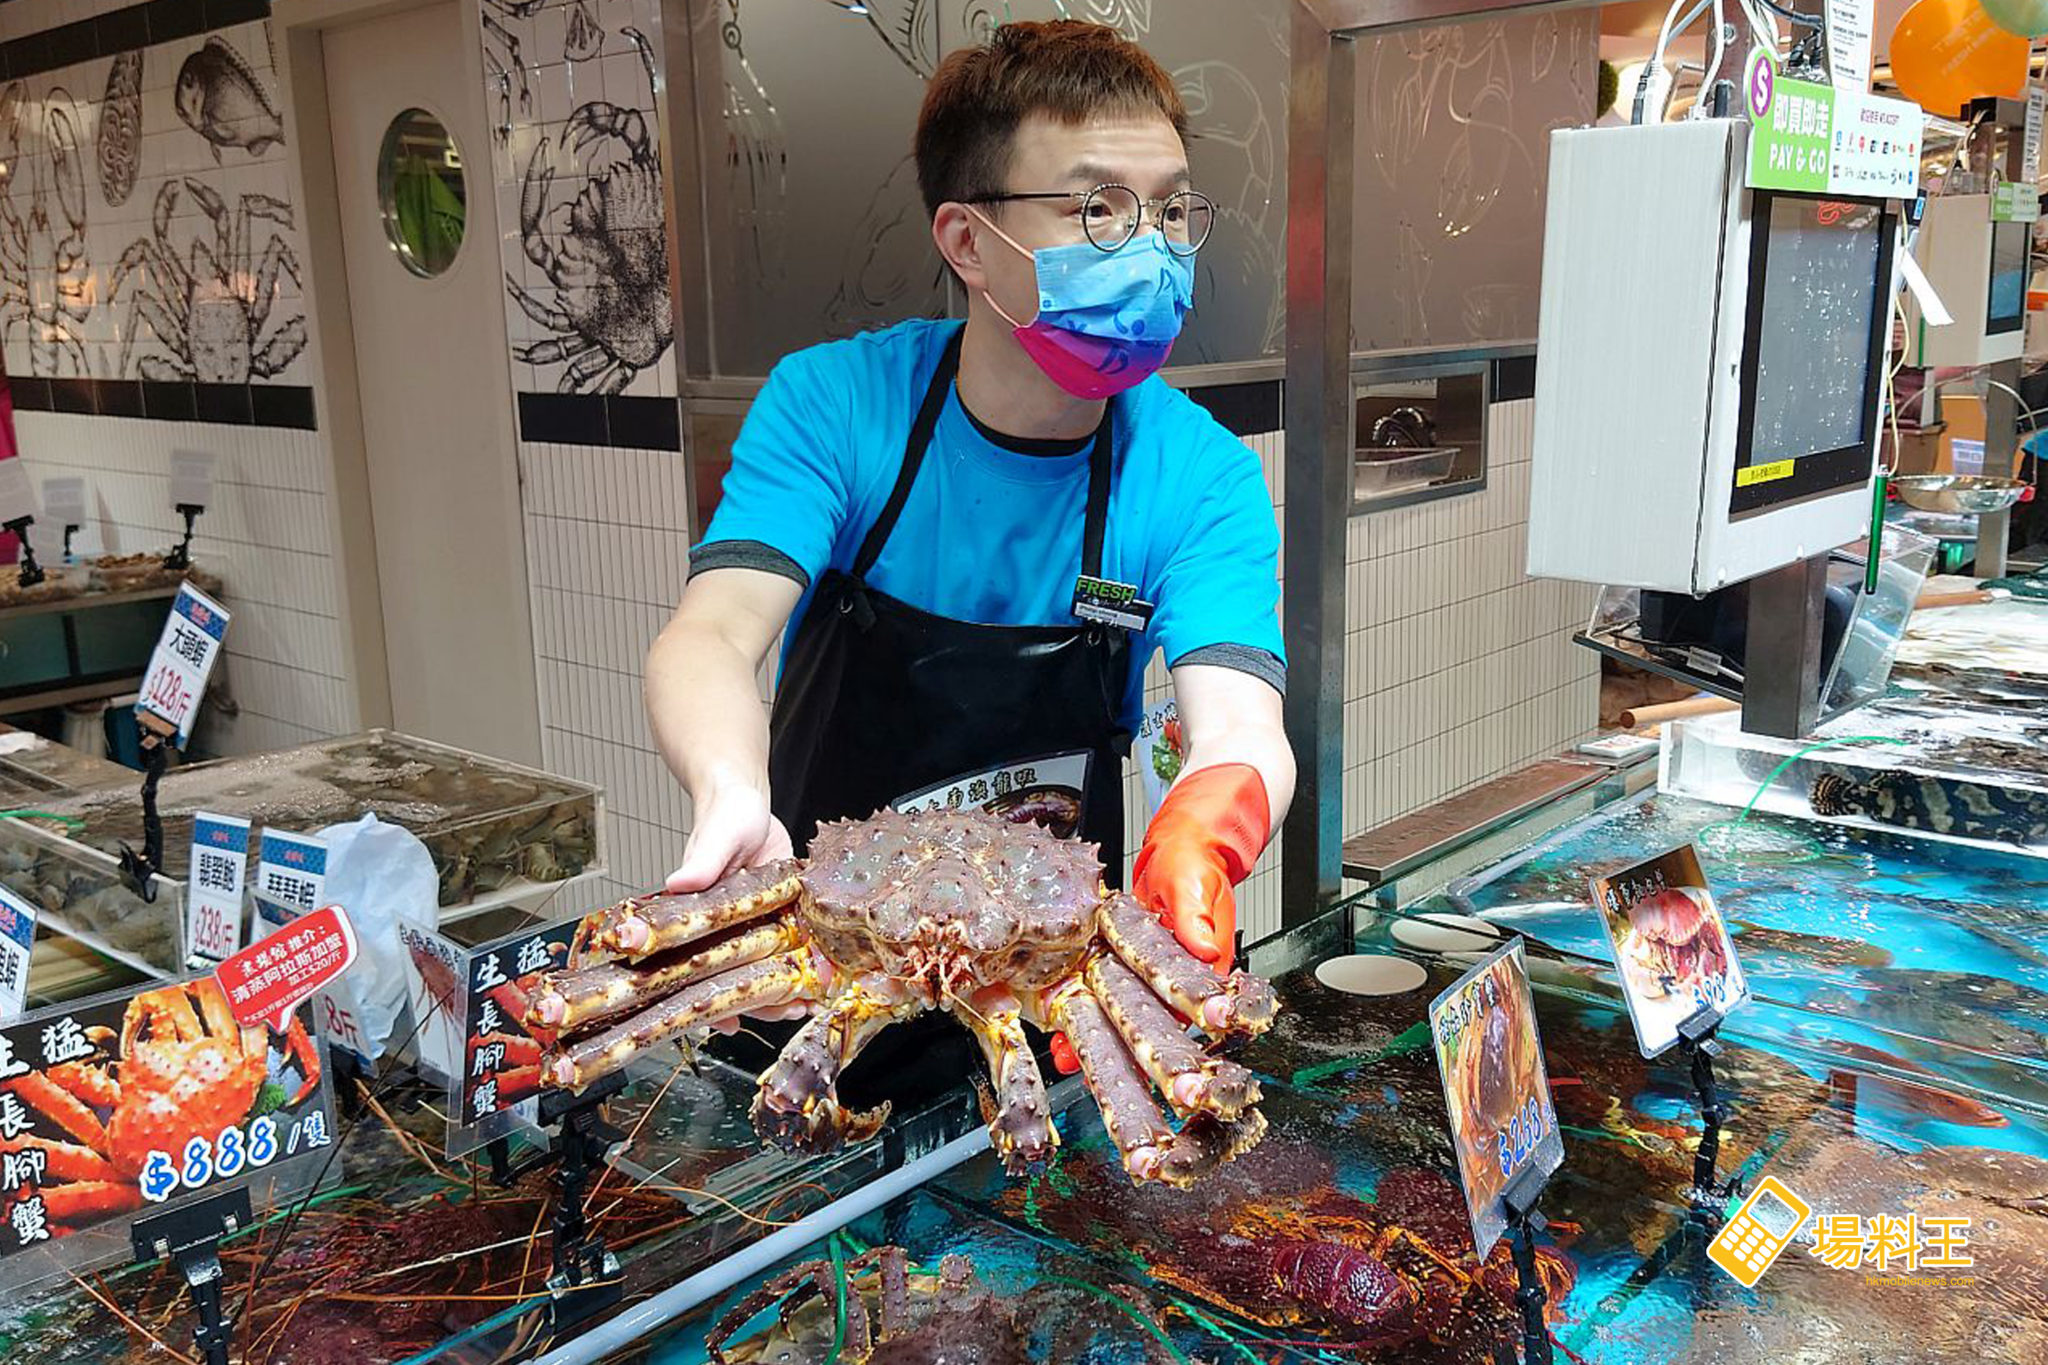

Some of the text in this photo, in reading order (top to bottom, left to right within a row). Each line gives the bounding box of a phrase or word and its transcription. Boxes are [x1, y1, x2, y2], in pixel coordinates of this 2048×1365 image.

[1773, 92, 1830, 138] 即買即走
[1769, 144, 1794, 170] PAY
[1796, 148, 1806, 172] &
[1809, 148, 1827, 174] GO
[1076, 579, 1136, 601] FRESH
[475, 936, 552, 993] 生猛
[471, 1000, 505, 1118] 長腳蟹
